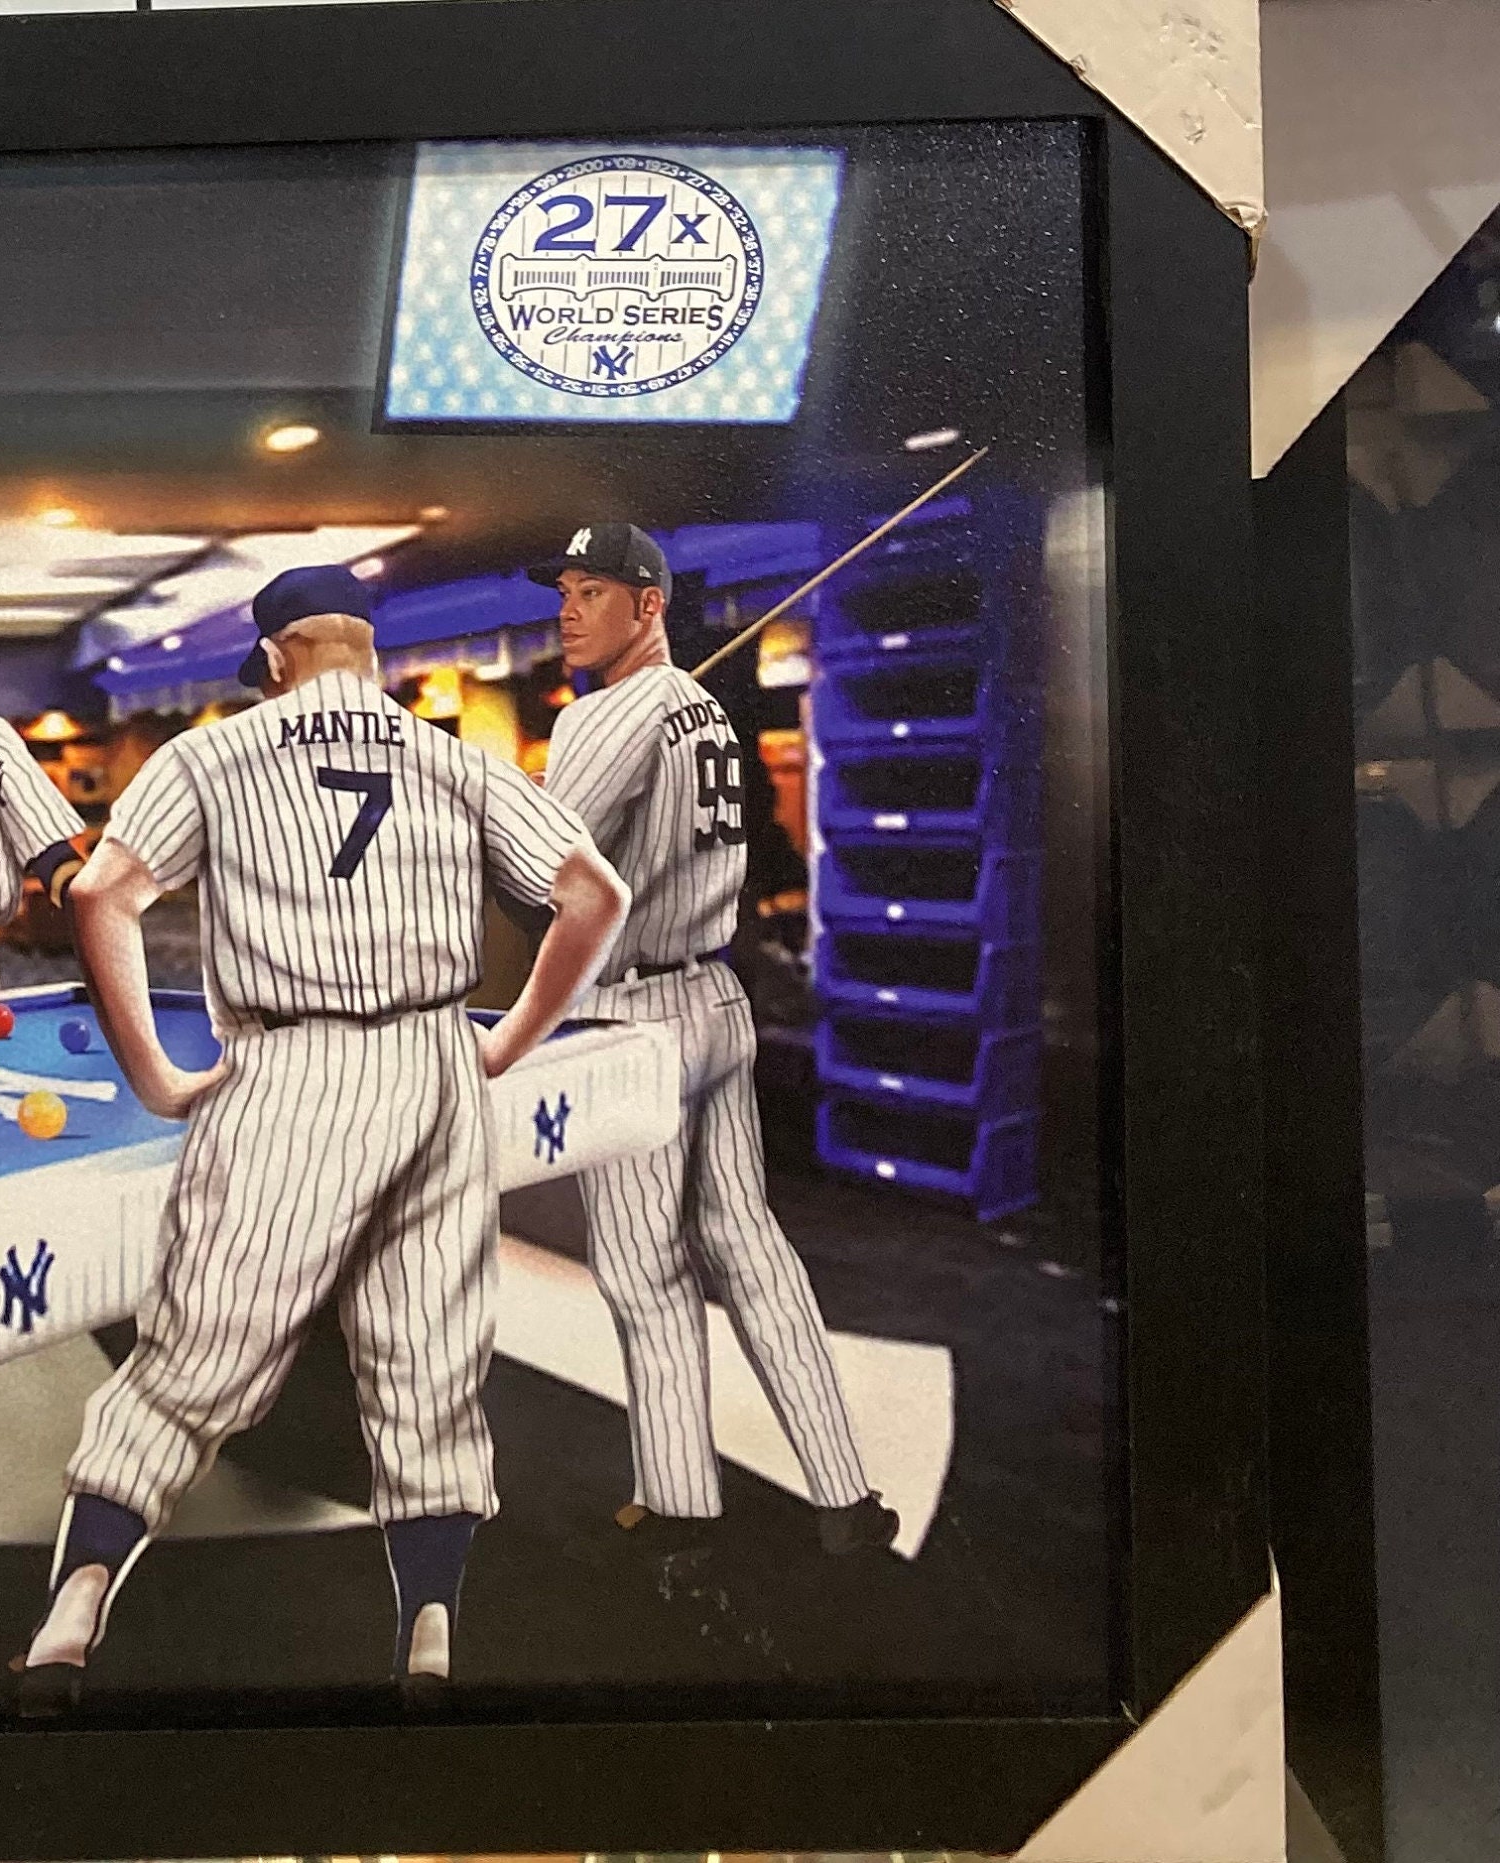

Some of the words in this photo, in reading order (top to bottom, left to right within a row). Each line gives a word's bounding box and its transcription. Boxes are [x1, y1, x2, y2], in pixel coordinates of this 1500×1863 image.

[564, 159, 604, 179] 2000
[645, 158, 680, 177] 1923
[507, 304, 614, 331] WORLD
[623, 304, 724, 332] SERIES
[543, 326, 684, 346] Champions
[592, 344, 635, 381] NY
[276, 710, 406, 749] MANTLE
[695, 739, 747, 853] 99
[316, 766, 393, 879] 7
[531, 1090, 571, 1165] NY
